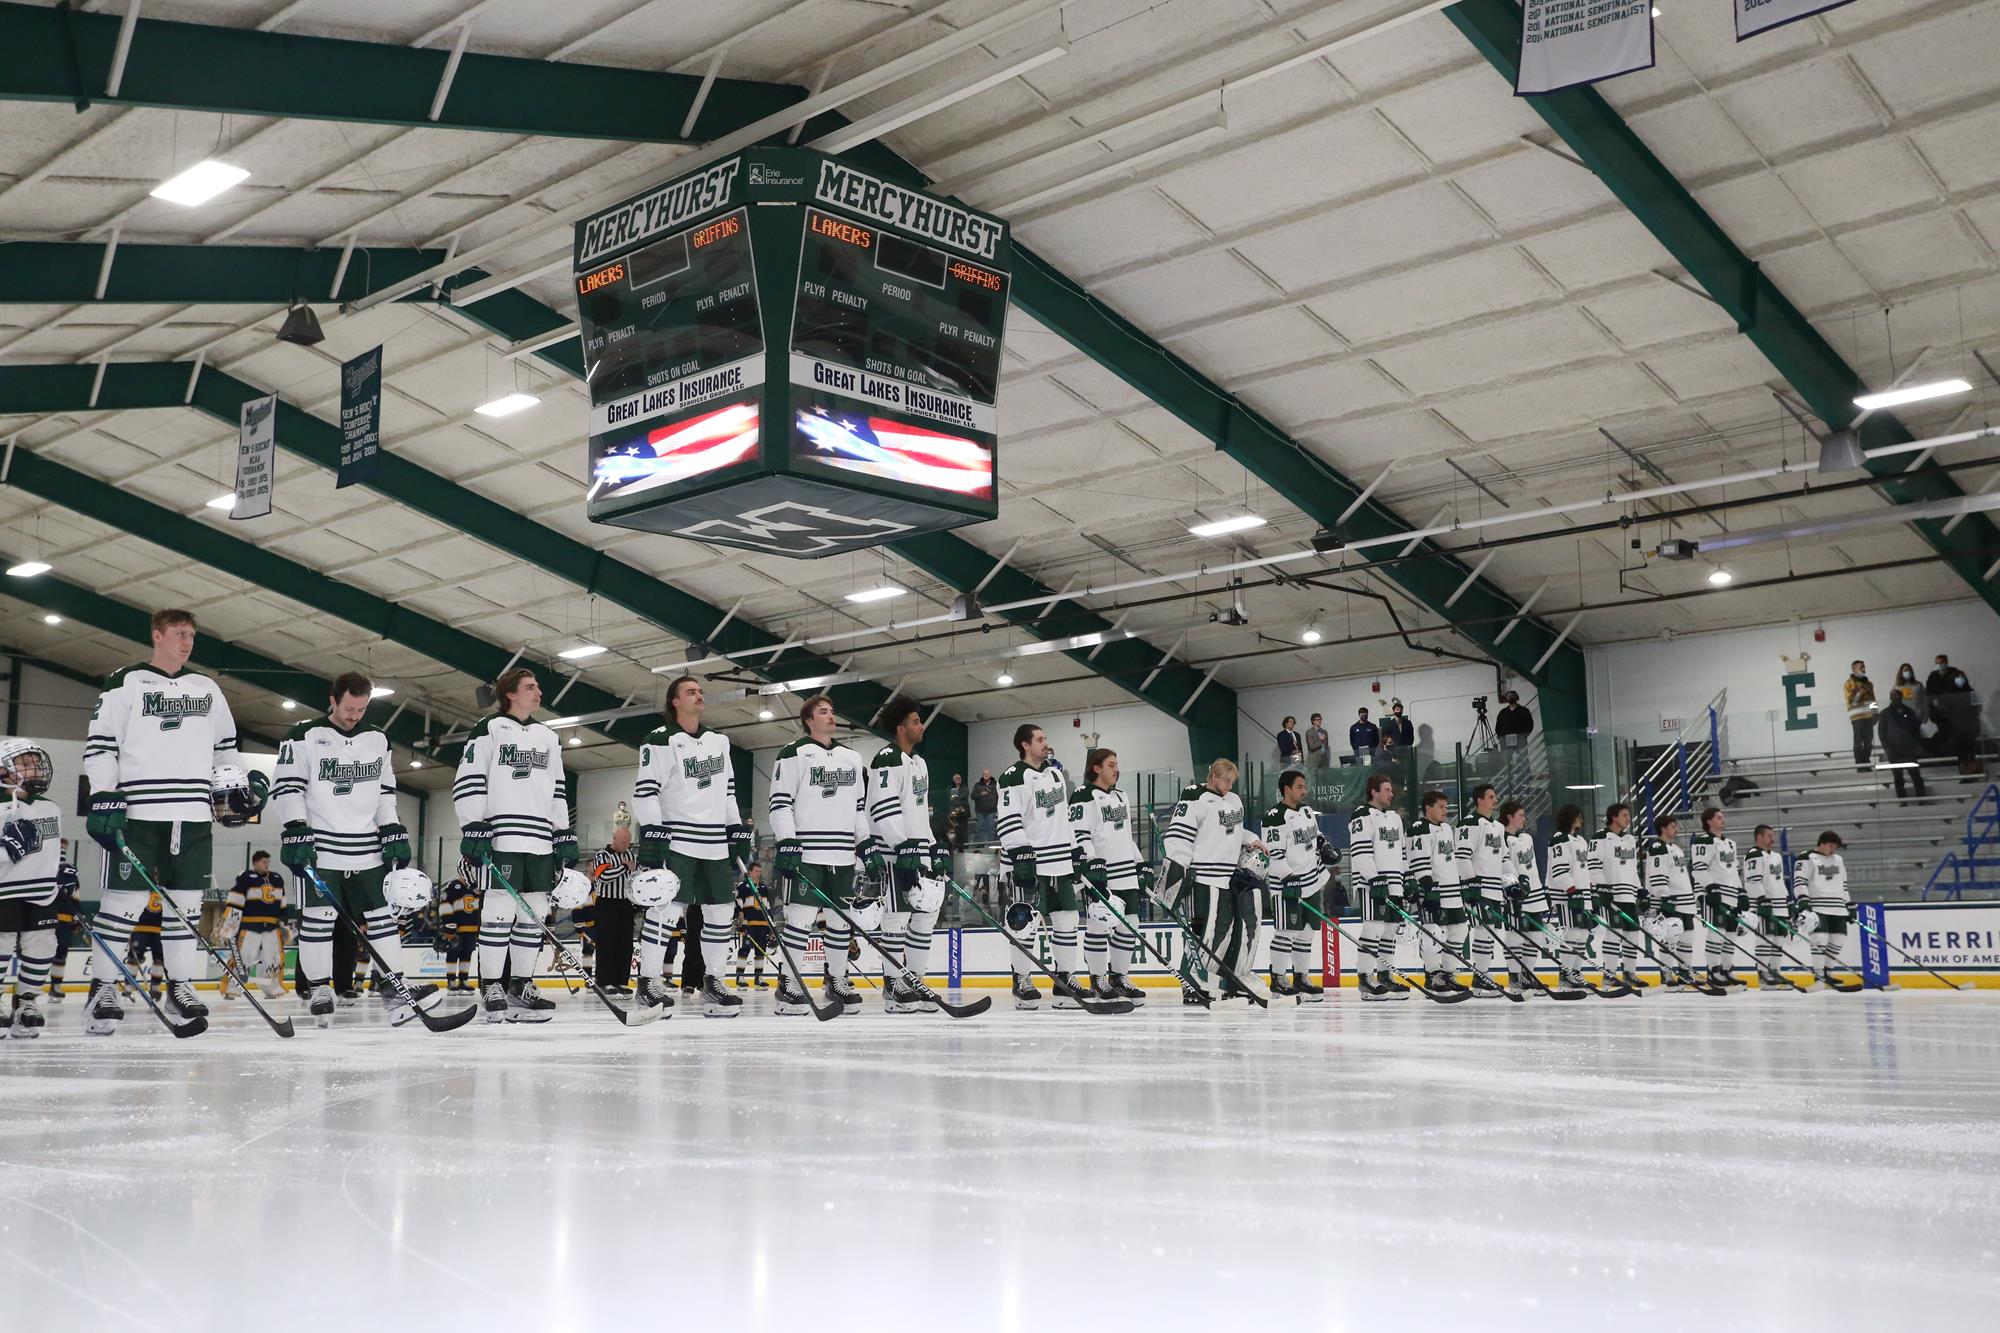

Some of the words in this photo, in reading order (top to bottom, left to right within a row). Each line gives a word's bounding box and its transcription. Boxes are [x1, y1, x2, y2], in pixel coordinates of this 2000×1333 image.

[1544, 10, 1585, 28] NATIONAL
[1544, 22, 1584, 39] NATIONAL
[1587, 4, 1645, 29] SEMIFINALIST
[766, 168, 780, 178] Erie
[766, 177, 804, 185] Insurance
[582, 160, 739, 260] MERCYHURST
[818, 163, 1000, 256] MERCYHURST
[693, 216, 739, 249] GRIFFINS
[812, 214, 871, 248] LAKERS
[579, 264, 624, 295] LAKERS
[952, 262, 1000, 291] GRIFFINS
[642, 291, 666, 310] PERIOD
[696, 296, 714, 312] PLYR
[718, 282, 750, 304] PENALTY
[804, 282, 826, 298] PLYR
[832, 290, 868, 310] PENALTY
[882, 282, 912, 301] PERIOD
[588, 336, 604, 350] PLYR
[608, 324, 636, 344] PENALTY
[939, 322, 958, 338] PLYR
[963, 330, 996, 348] PENALTY
[647, 371, 670, 386] SHOTS
[670, 367, 680, 378] ON
[682, 360, 700, 376] GOAL
[866, 358, 892, 376] SHOTS
[894, 366, 906, 378] ON
[907, 370, 927, 384] GOAL
[608, 400, 639, 424] GREAT
[642, 388, 675, 414] LAKES
[680, 366, 741, 402] INSURANCE
[814, 362, 856, 392] GREAT
[860, 374, 900, 402] LAKES
[904, 386, 973, 422] INSURANCE
[904, 406, 936, 419] SERVICES
[143, 692, 212, 732] Mercyhurst
[277, 744, 294, 764] 11
[642, 748, 650, 766] 3
[319, 757, 382, 796] Mercyhurst
[880, 770, 888, 788] 7
[92, 802, 127, 811] BAUE
[1003, 790, 1010, 806] 5
[283, 835, 316, 844] BAUE
[382, 833, 409, 844] BAUE
[464, 830, 494, 838] BAUE
[732, 832, 752, 840] BAU
[1266, 829, 1280, 844] 26
[1352, 819, 1364, 834] 23
[553, 836, 578, 844] BAUE
[1326, 922, 1336, 976] BAUER
[1866, 904, 1881, 976] BAUER
[1901, 931, 2000, 949] MERRI
[560, 950, 596, 988] BAUER
[1914, 954, 1948, 964] BANK
[1952, 954, 1968, 964] OF
[1972, 954, 2000, 964] AME
[386, 972, 417, 1008] BAUER
[900, 966, 935, 999] BAUER
